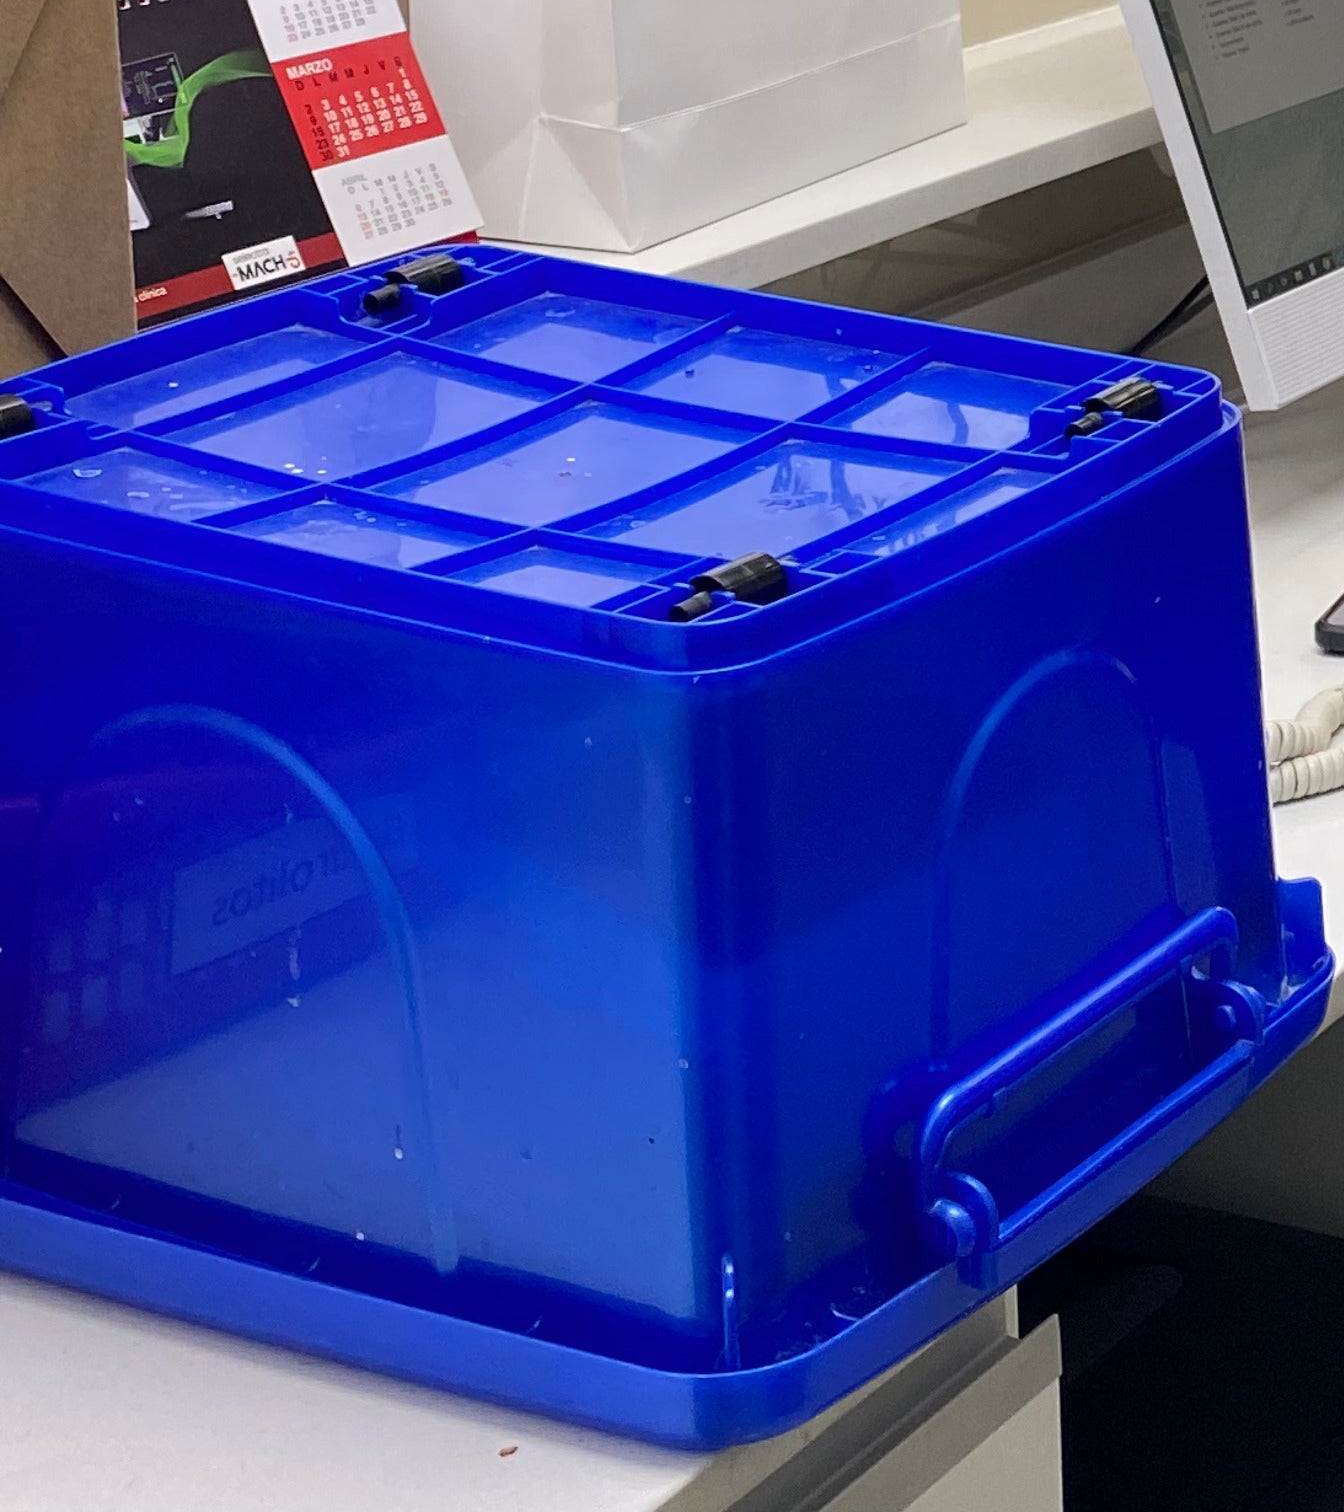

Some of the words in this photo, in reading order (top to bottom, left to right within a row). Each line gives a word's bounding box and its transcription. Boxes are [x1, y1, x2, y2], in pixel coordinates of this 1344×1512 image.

[285, 58, 333, 80] MARZO
[399, 68, 406, 77] 1
[313, 78, 321, 87] L
[321, 99, 330, 110] 3
[338, 95, 348, 105] 4
[354, 91, 363, 102] 5
[386, 82, 395, 93] 7
[324, 110, 337, 122] 10
[341, 106, 353, 118] 11
[356, 102, 370, 113] 12
[389, 94, 402, 105] 14
[328, 122, 341, 134] 17
[393, 106, 406, 117] 21
[336, 145, 350, 158] 31
